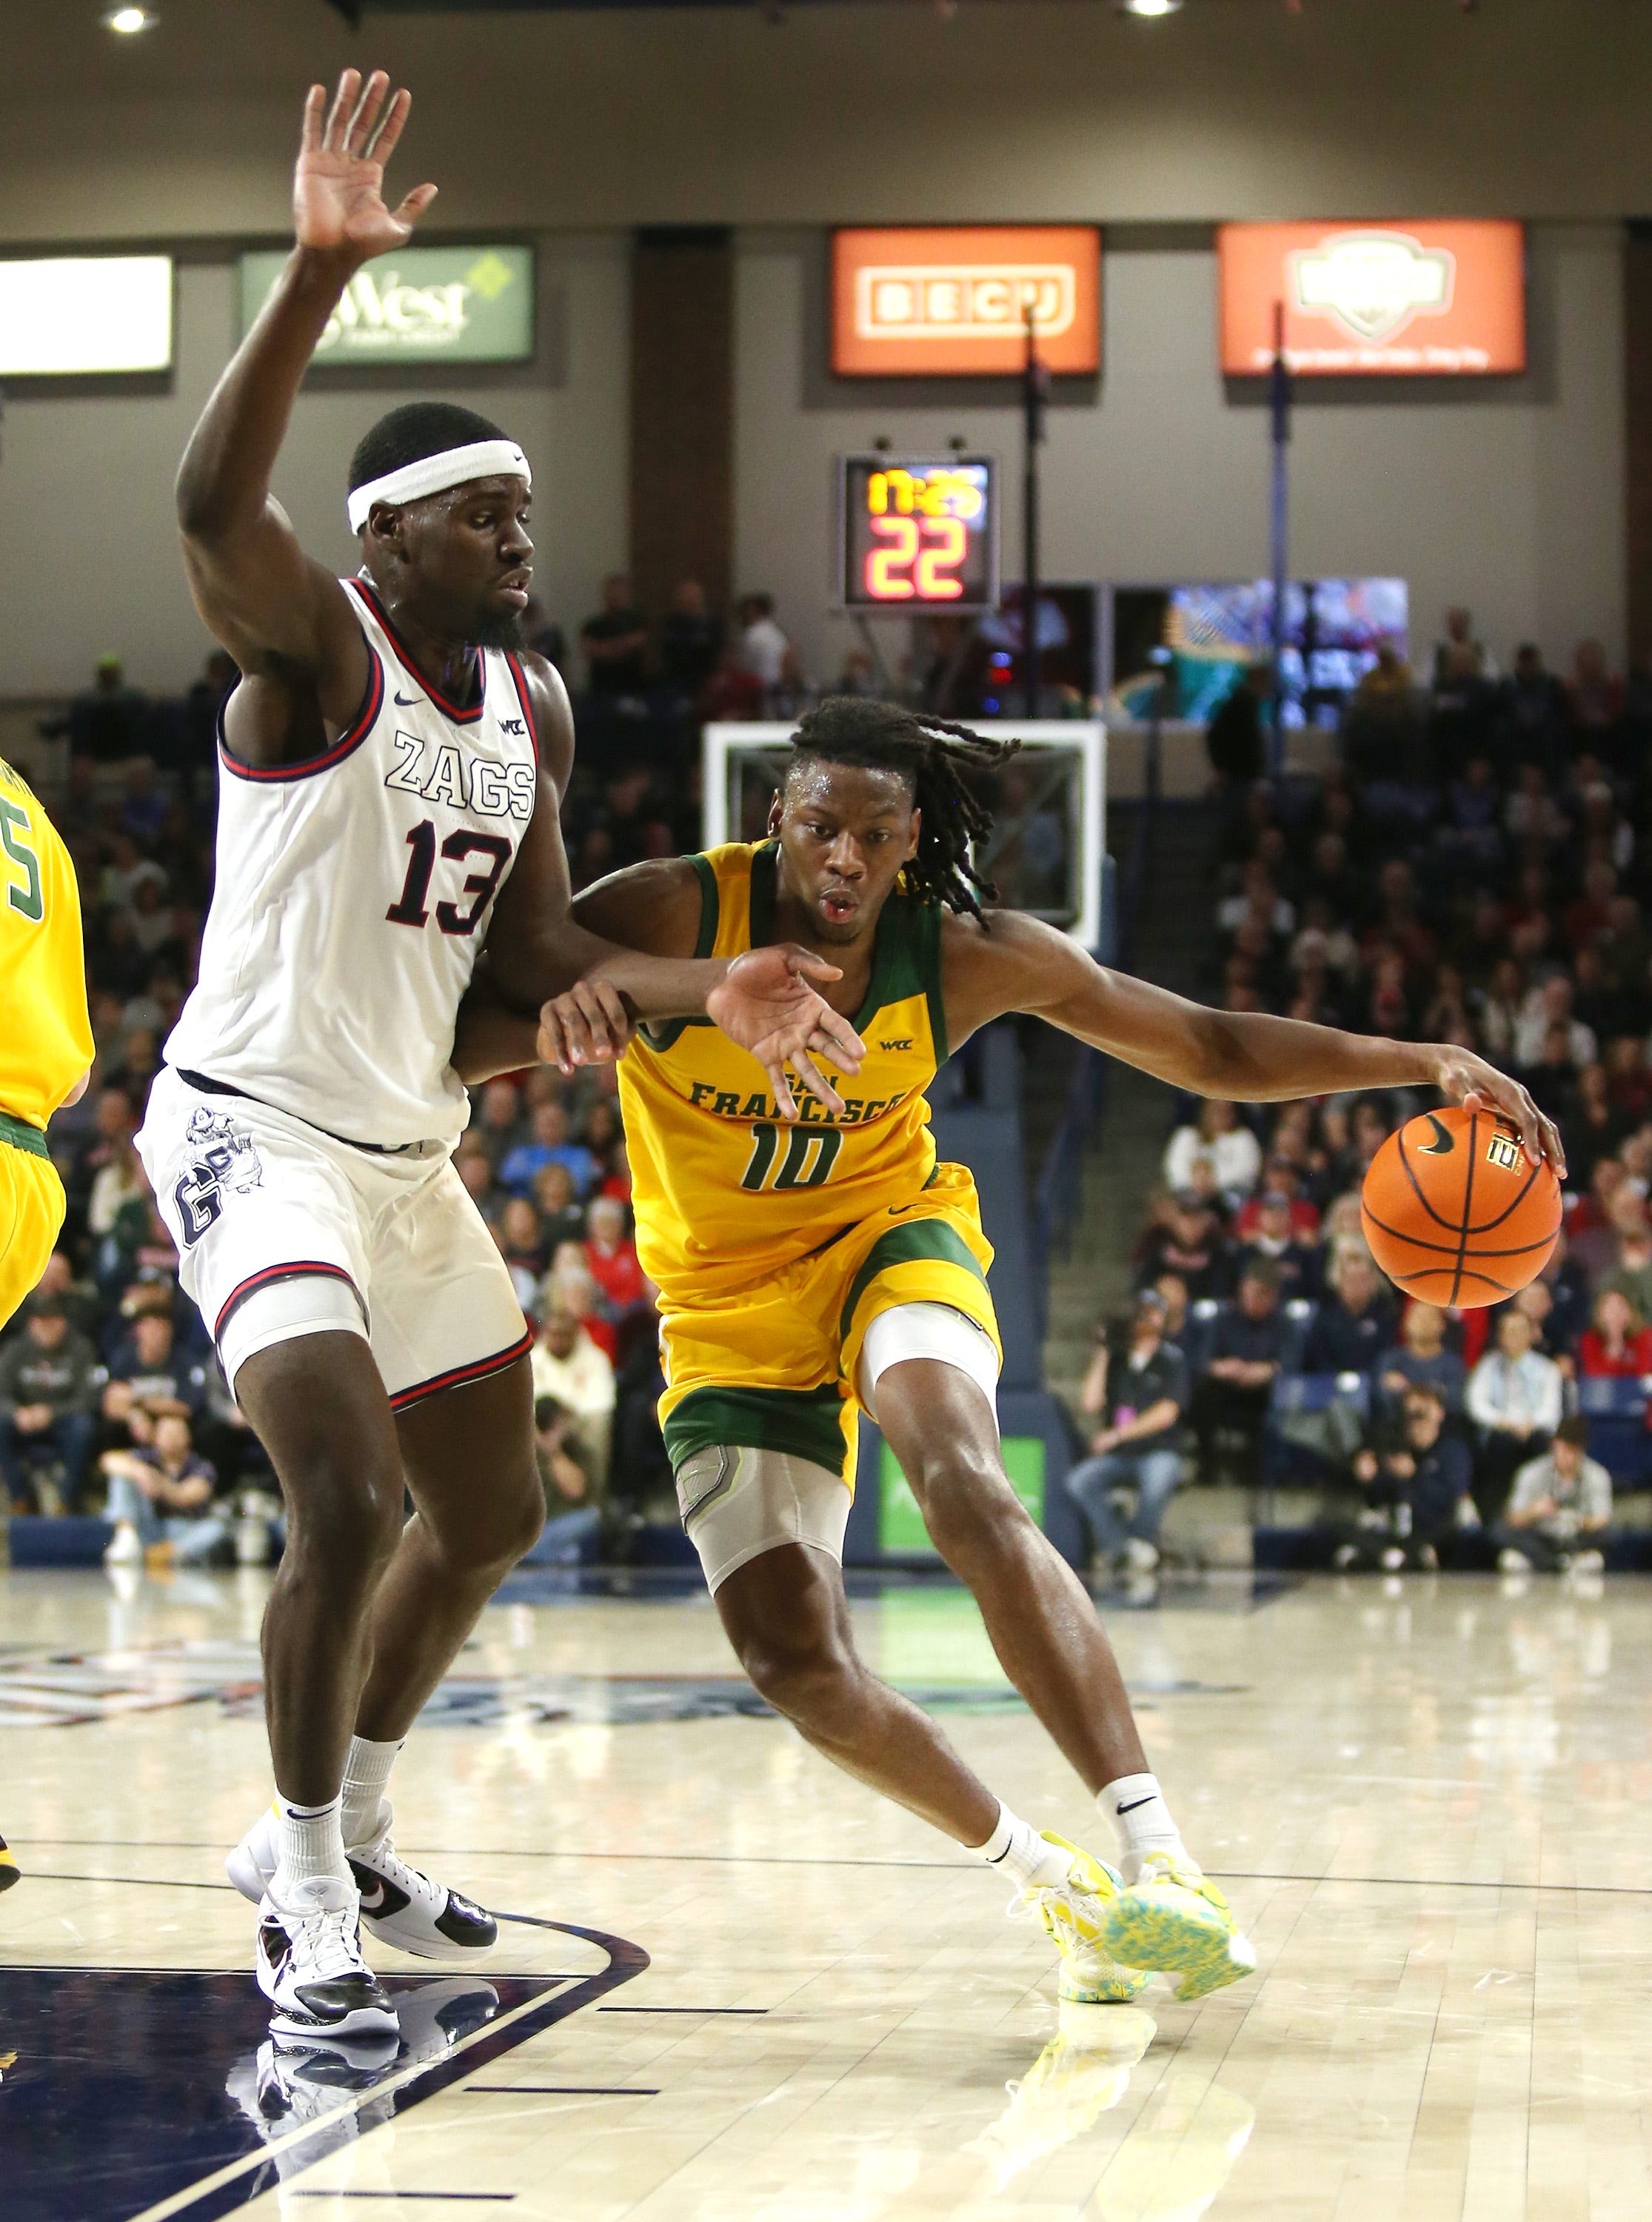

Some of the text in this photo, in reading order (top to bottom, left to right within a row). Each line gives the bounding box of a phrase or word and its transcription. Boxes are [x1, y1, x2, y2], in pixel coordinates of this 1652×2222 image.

[317, 270, 469, 350] West
[872, 277, 1061, 324] BECU
[865, 515, 969, 598] 22
[384, 730, 536, 820] ZAGS
[0, 795, 44, 924] 5
[385, 819, 512, 935] 13
[740, 1122, 844, 1192] 10
